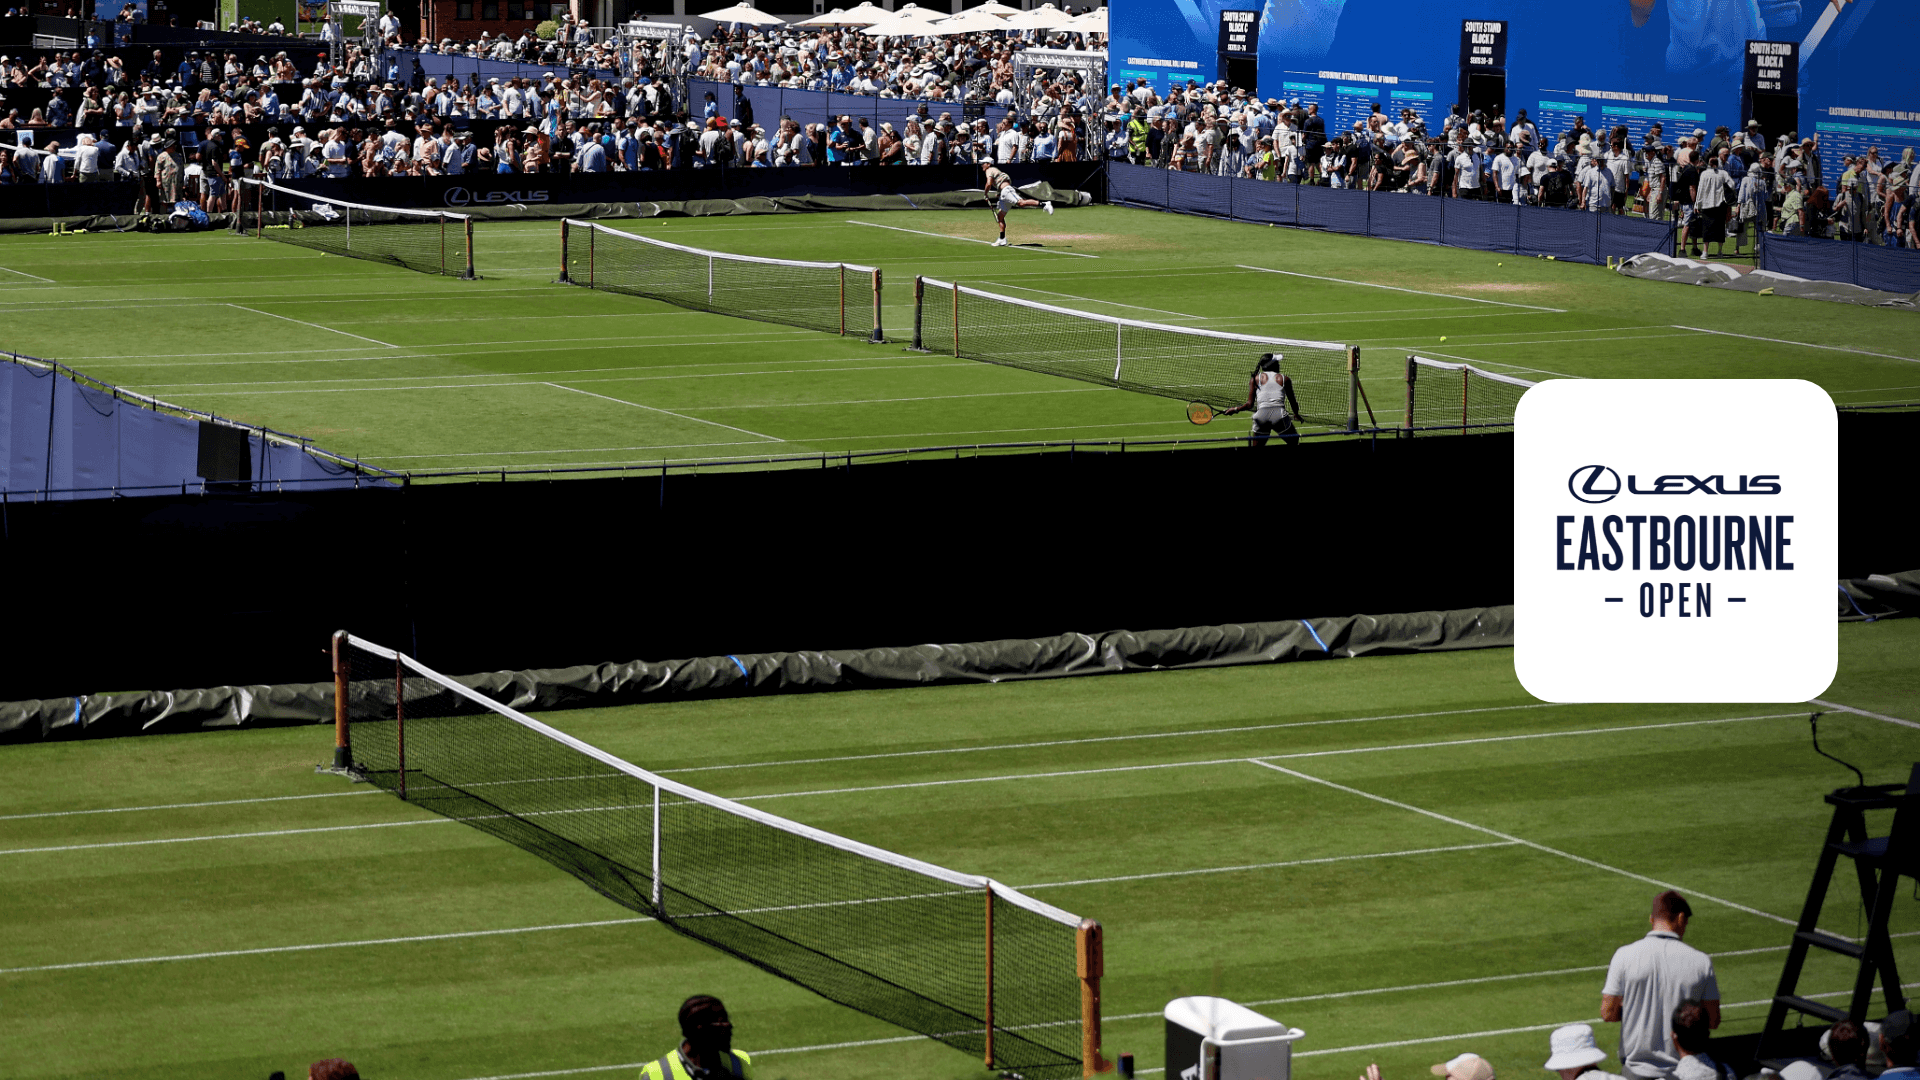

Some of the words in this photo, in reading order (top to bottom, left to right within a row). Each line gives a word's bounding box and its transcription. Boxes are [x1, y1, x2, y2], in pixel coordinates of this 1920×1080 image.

[1223, 11, 1239, 21] SOUTH
[1239, 12, 1254, 22] STAND
[1229, 22, 1244, 32] BLOCK
[1244, 22, 1248, 33] C
[1465, 21, 1483, 32] SOUTH
[1483, 22, 1501, 33] STAND
[1472, 33, 1490, 44] BLOCK
[1490, 33, 1494, 44] B
[1480, 47, 1492, 55] ROWS
[1749, 42, 1770, 54] SOUTH
[1771, 43, 1791, 56] STAND
[1757, 55, 1778, 67] BLOCK
[1778, 56, 1783, 68] A
[1758, 69, 1767, 78] ALL
[1767, 70, 1781, 79] ROWS
[1757, 81, 1770, 89] SEATS
[1575, 88, 1601, 98] EASTBOURNE
[1602, 91, 1633, 101] INTERNATIONAL
[1634, 93, 1644, 102] ROLL
[1651, 94, 1668, 103] HONOUR
[1828, 106, 1860, 117] EASTBOURNE
[1860, 108, 1895, 119] INTERNATIONAL
[1896, 111, 1908, 120] ROLL
[1908, 112, 1915, 121] OF
[473, 190, 549, 202] LEXUS
